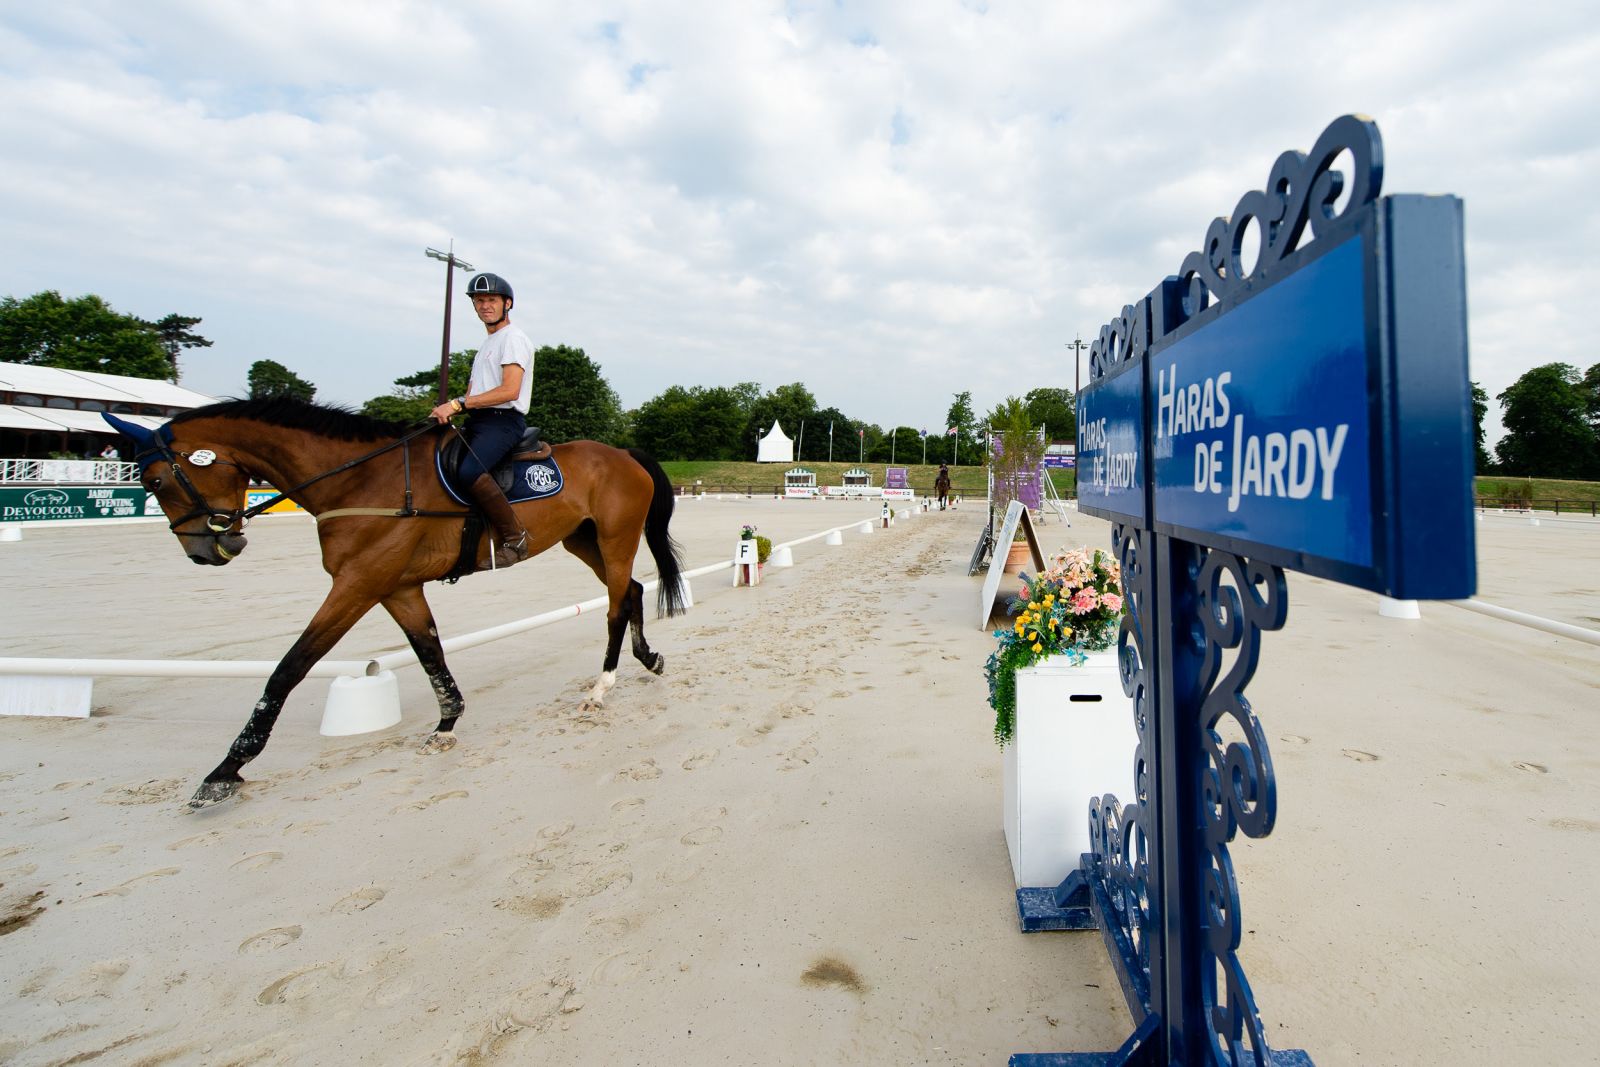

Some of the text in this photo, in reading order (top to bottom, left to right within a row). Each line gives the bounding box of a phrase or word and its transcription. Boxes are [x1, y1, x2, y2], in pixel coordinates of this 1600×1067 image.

[1093, 442, 1138, 497] DE JARDY
[1194, 414, 1349, 513] DE JARDY
[87, 489, 115, 499] JARDY
[95, 498, 134, 508] EVENTING
[3, 505, 85, 517] DEVOUCOUX
[112, 506, 137, 516] SHOW
[740, 544, 749, 558] F
